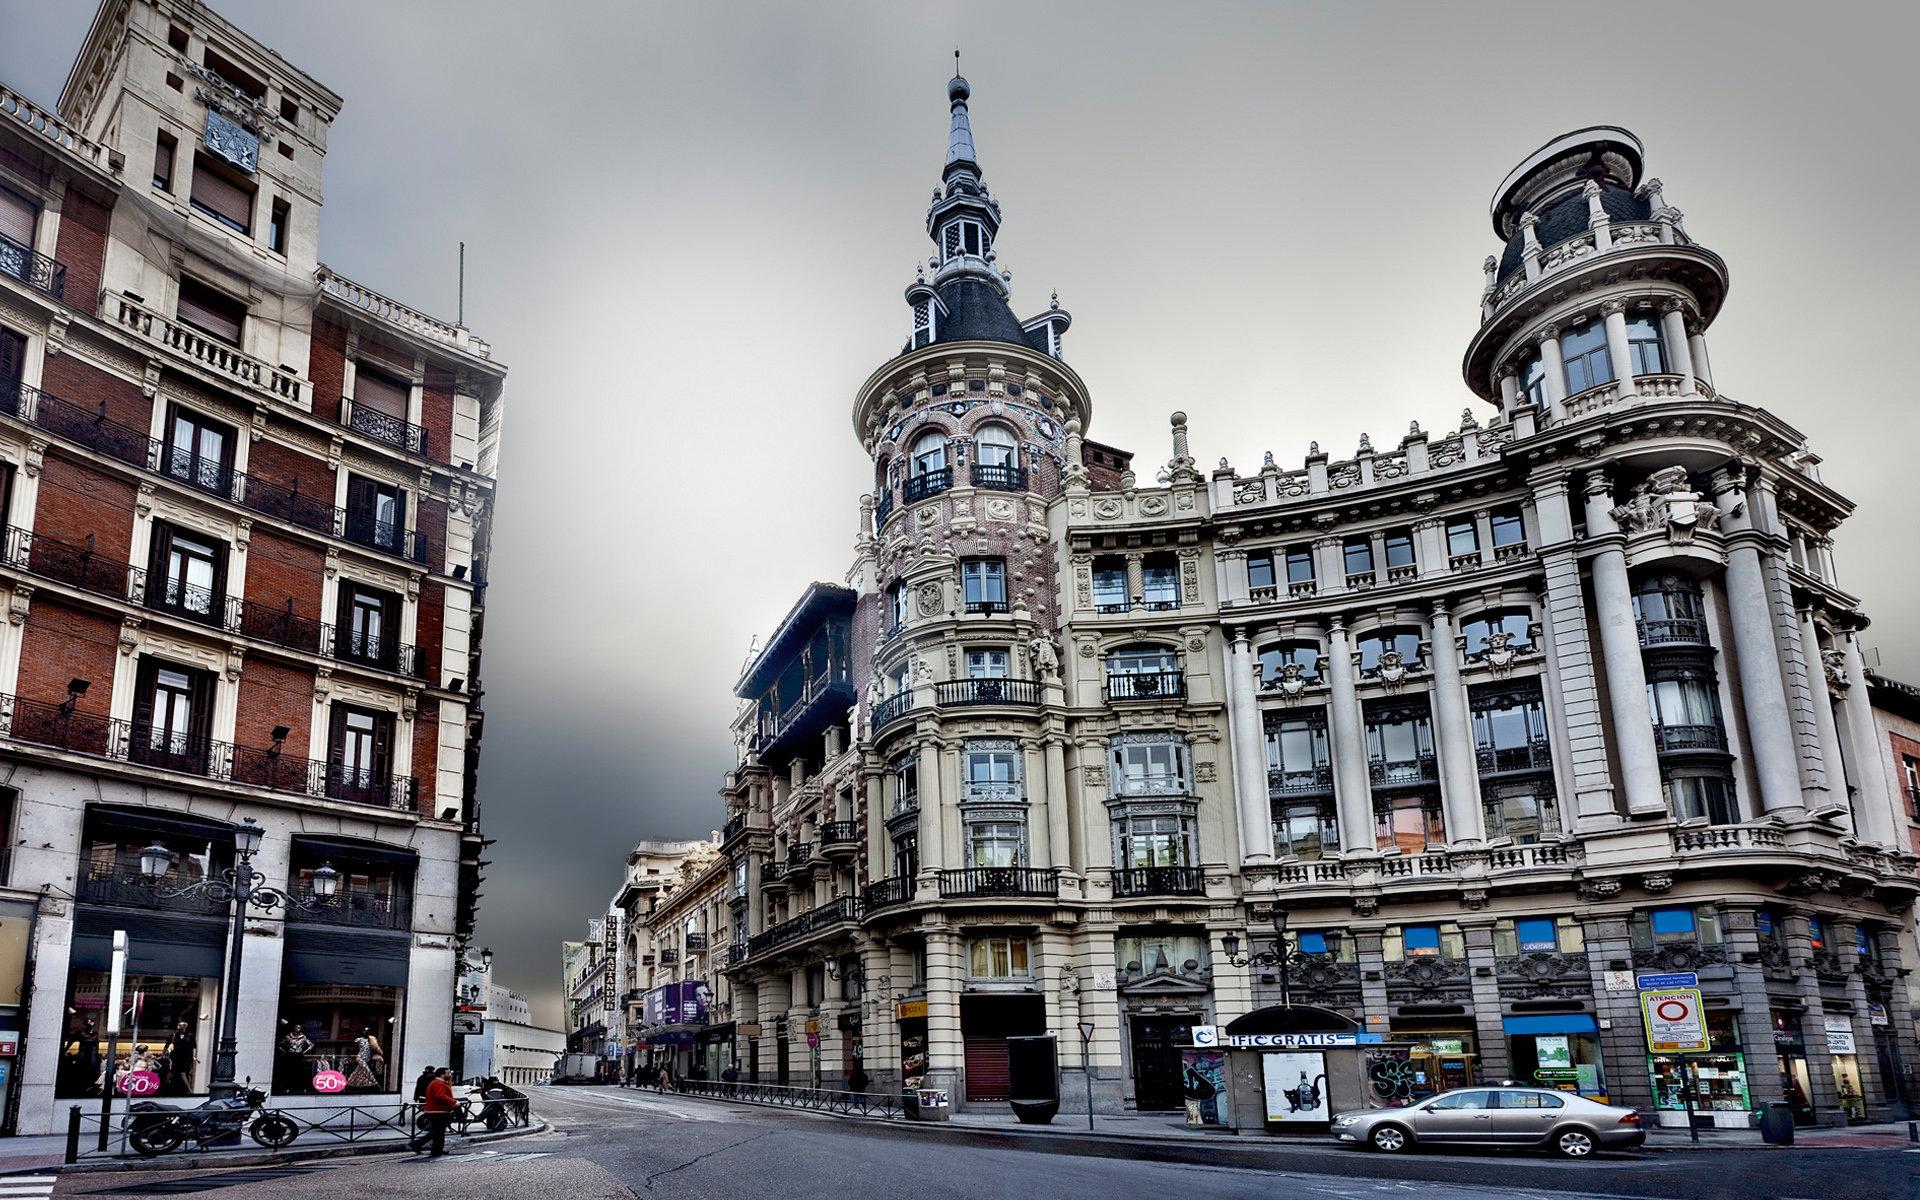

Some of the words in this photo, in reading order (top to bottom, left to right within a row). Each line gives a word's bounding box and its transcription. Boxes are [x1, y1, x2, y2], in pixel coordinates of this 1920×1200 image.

[606, 916, 616, 948] HOTEL
[605, 951, 615, 1010] SANTANDER
[1271, 1034, 1336, 1045] GRATIS
[315, 1076, 347, 1090] 50%
